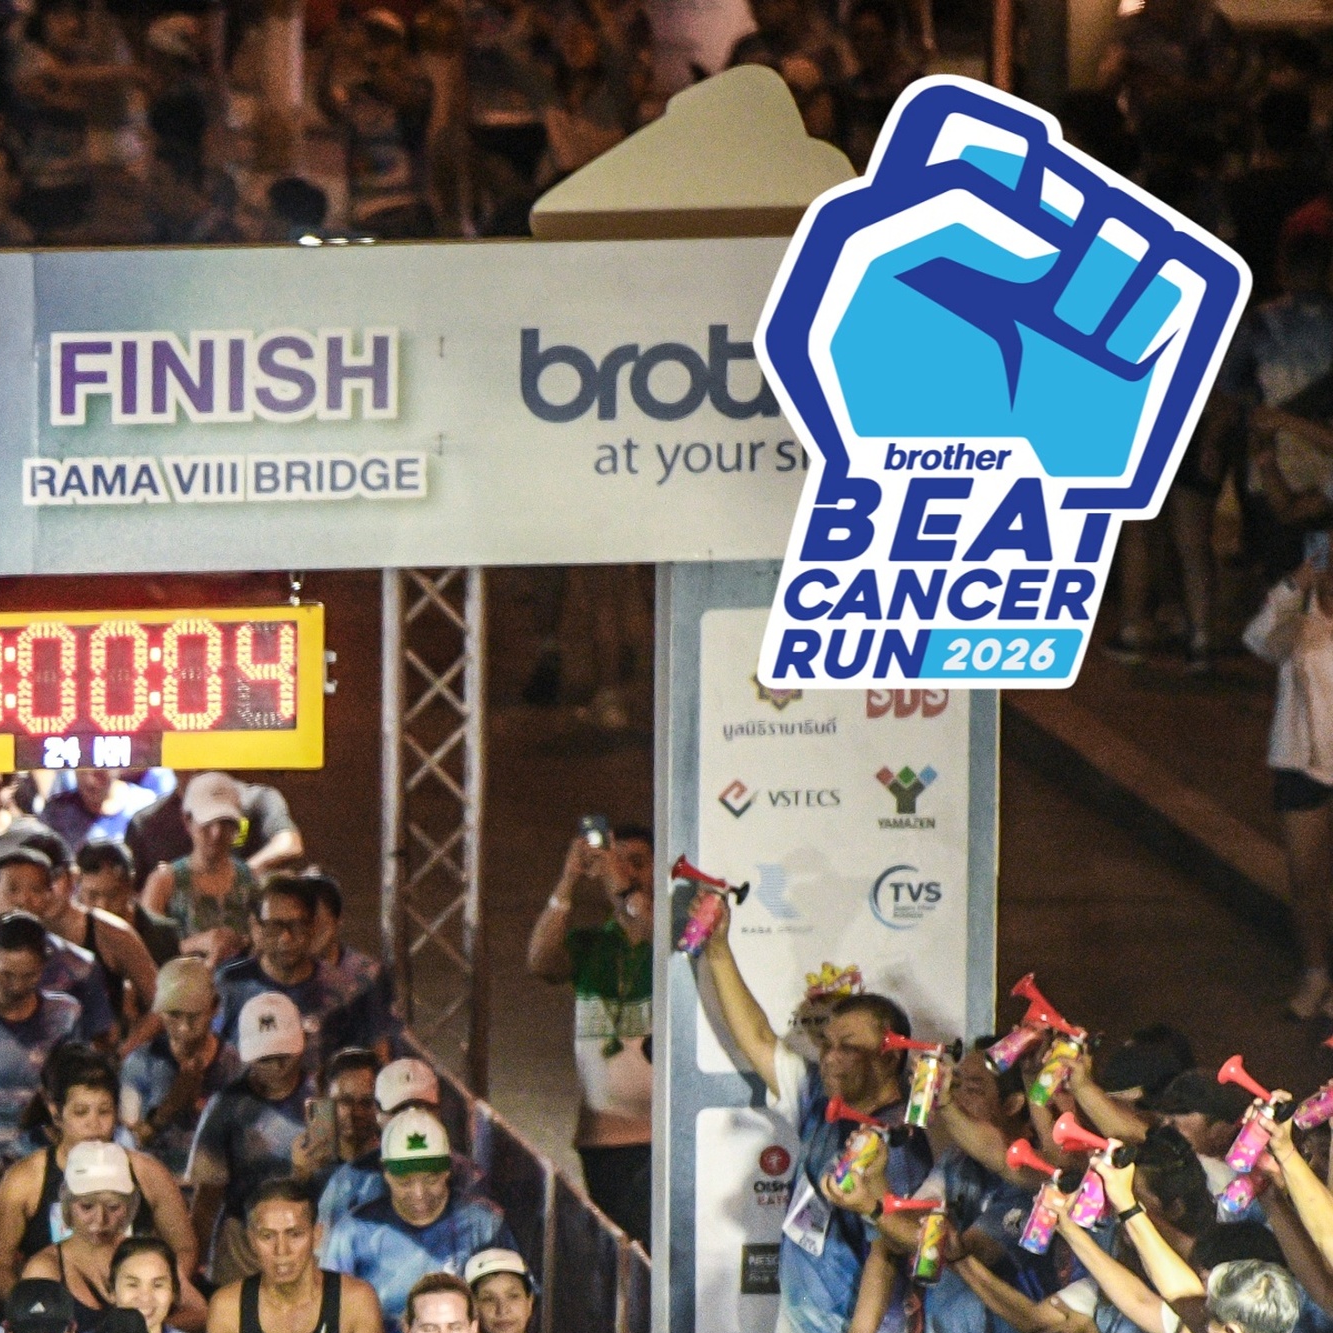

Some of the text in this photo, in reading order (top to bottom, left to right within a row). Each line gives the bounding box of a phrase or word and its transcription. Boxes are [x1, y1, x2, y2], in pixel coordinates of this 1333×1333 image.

[59, 335, 390, 416] FINISH
[521, 324, 780, 423] brot
[32, 458, 421, 497] RAMA VIII BRIDGE
[594, 438, 808, 483] at your si
[43, 737, 80, 768] 24
[878, 817, 936, 830] YAMAZEN
[889, 881, 942, 903] TVS
[753, 1180, 791, 1193] OISH
